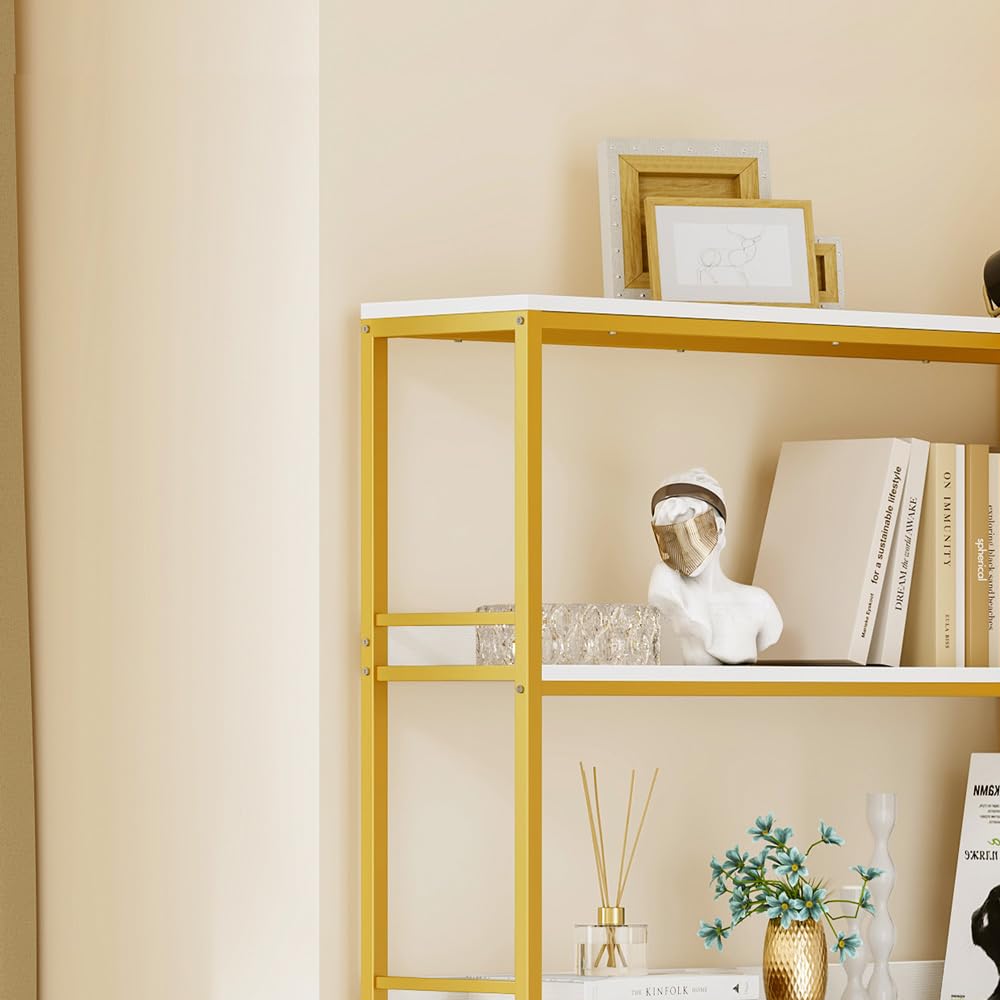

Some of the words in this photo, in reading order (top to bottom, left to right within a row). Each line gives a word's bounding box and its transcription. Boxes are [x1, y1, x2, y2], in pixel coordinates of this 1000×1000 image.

[943, 472, 952, 489] ON
[871, 570, 880, 584] for
[877, 505, 894, 560] sustainable
[888, 466, 902, 503] lifestyle
[905, 497, 918, 536] AWAKE
[943, 497, 952, 567] IMMUNITY
[900, 558, 909, 570] the
[904, 536, 913, 558] world
[975, 538, 987, 581] spherical
[895, 570, 907, 611] DREAM
